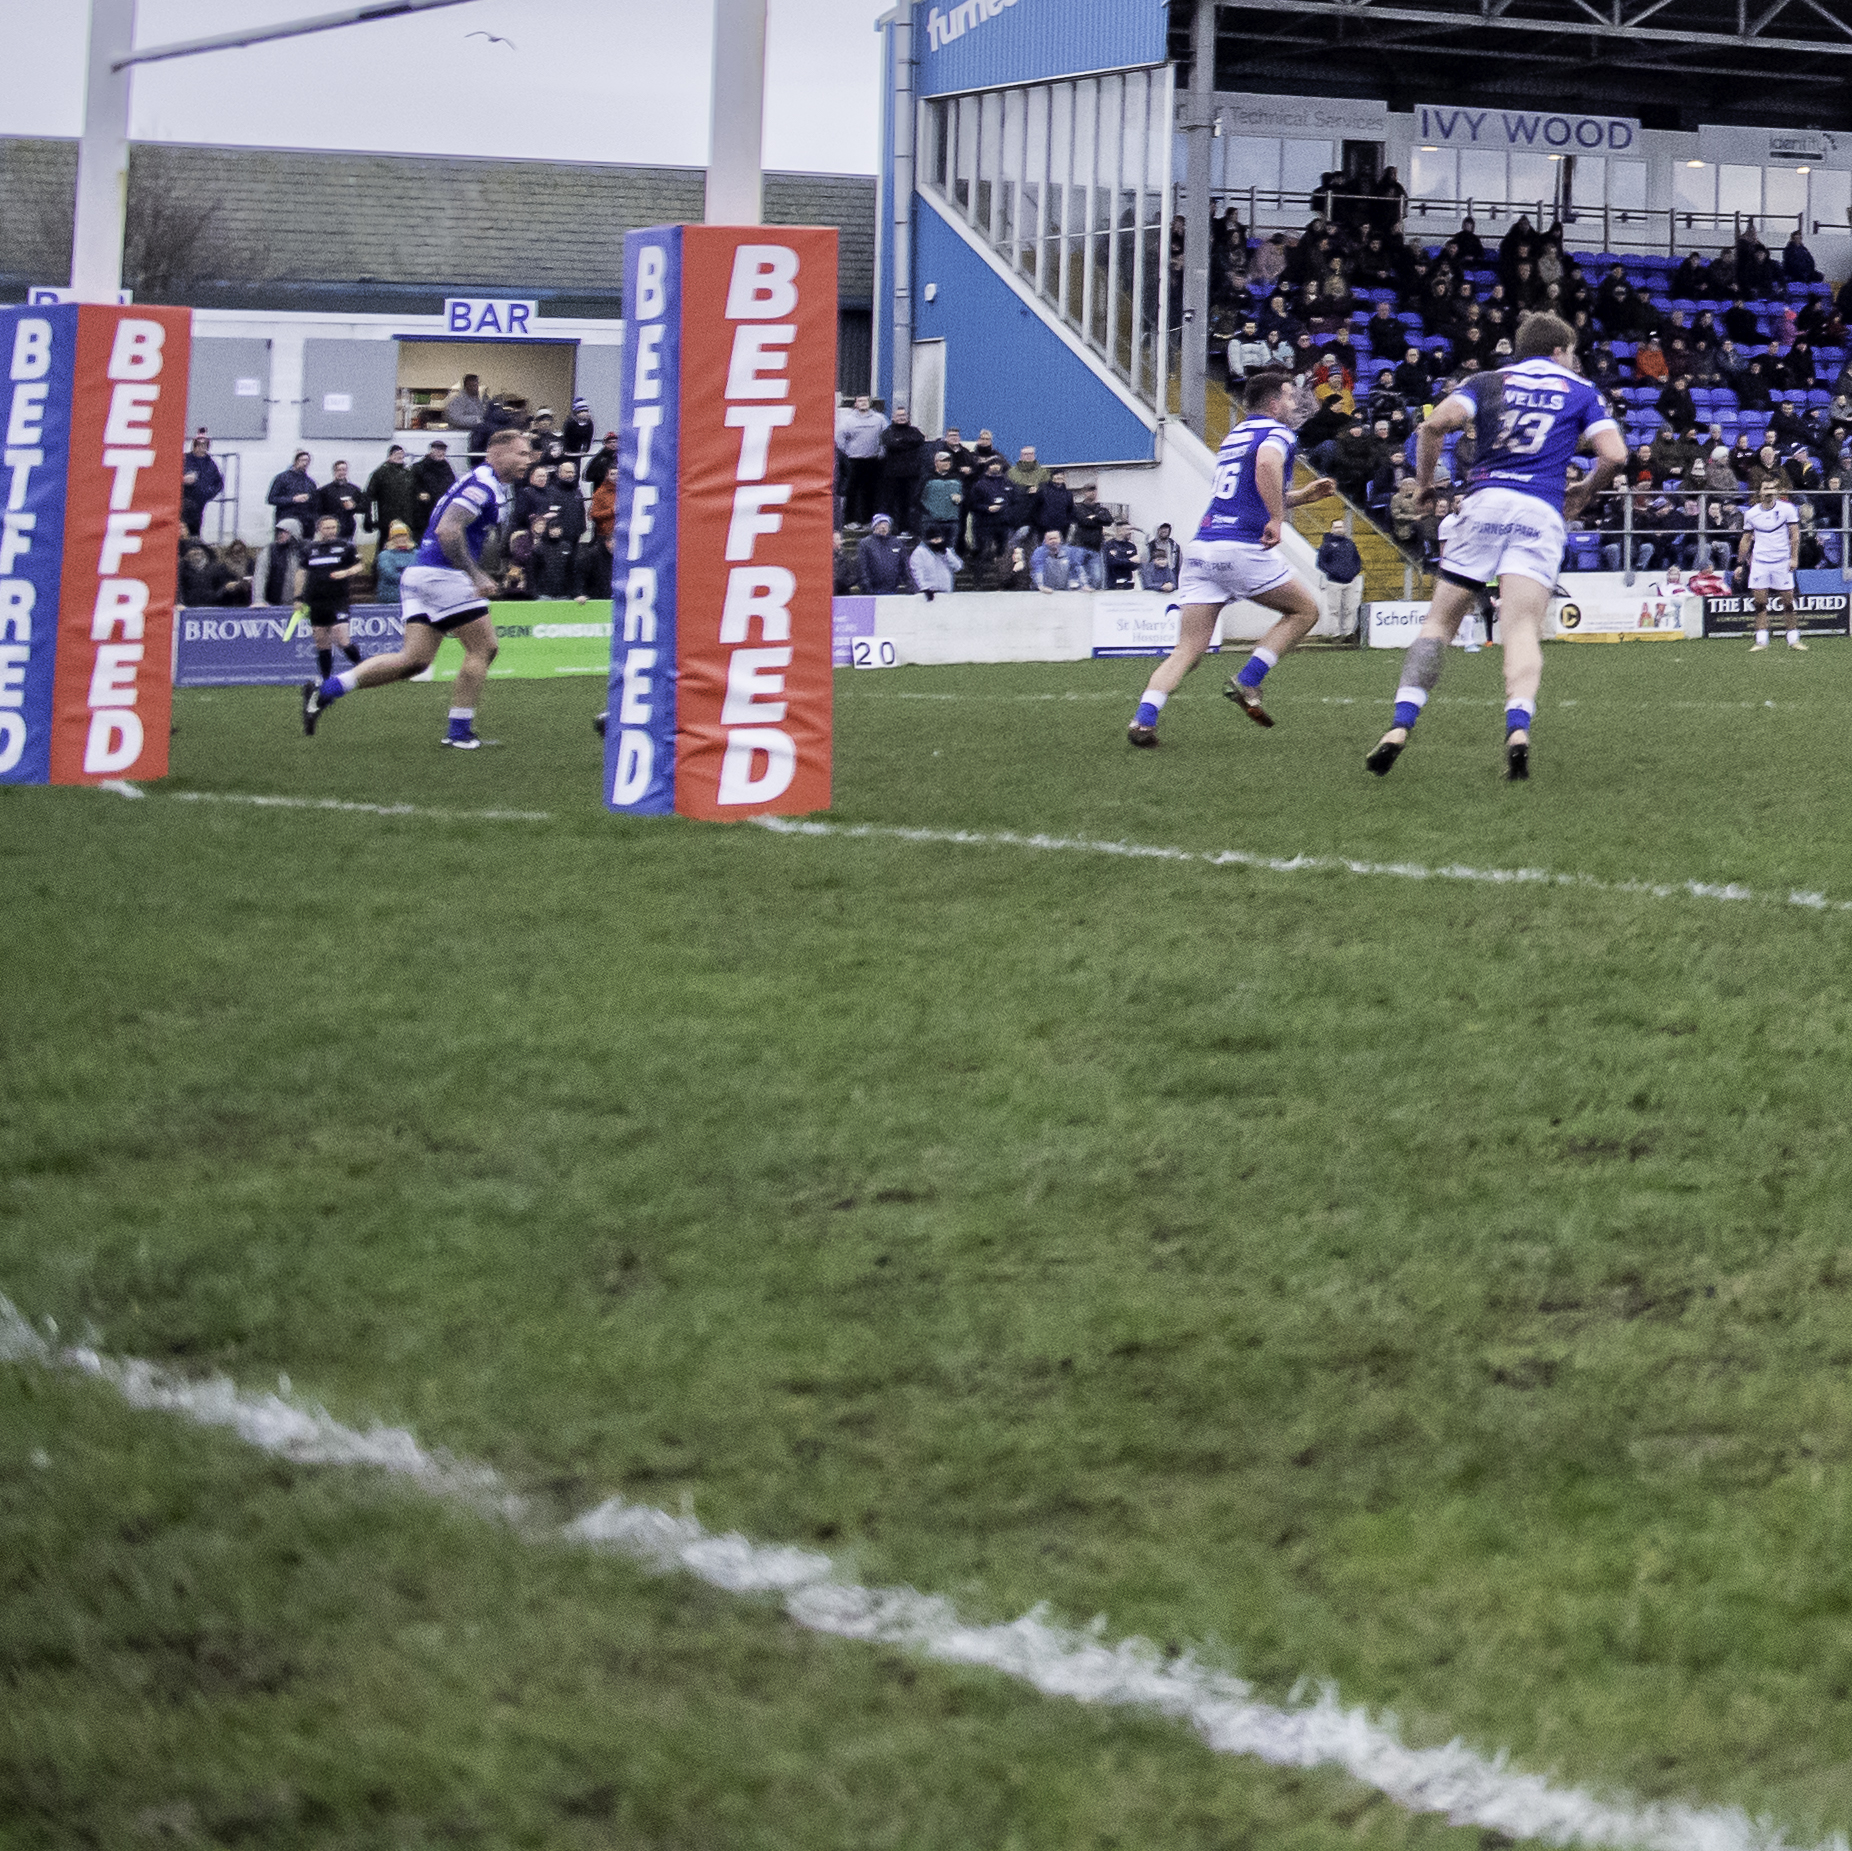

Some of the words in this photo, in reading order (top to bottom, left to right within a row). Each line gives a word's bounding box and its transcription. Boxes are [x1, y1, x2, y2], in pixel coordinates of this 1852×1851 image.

[1422, 109, 1487, 141] IVY
[1502, 113, 1632, 149] WOOD
[450, 302, 529, 334] BAR
[1504, 390, 1564, 410] WELLS
[1492, 409, 1555, 454] 13
[612, 245, 667, 805] BETFRED
[717, 244, 799, 805] BETFRED
[84, 318, 165, 774] BETFRED
[1708, 598, 1740, 613] THE
[1744, 598, 1784, 612] KNG
[185, 619, 288, 641] BROWN
[1133, 618, 1175, 634] Mary's
[1376, 611, 1427, 626] Schofie
[1132, 632, 1175, 644] Hospice
[854, 641, 896, 666] 20
